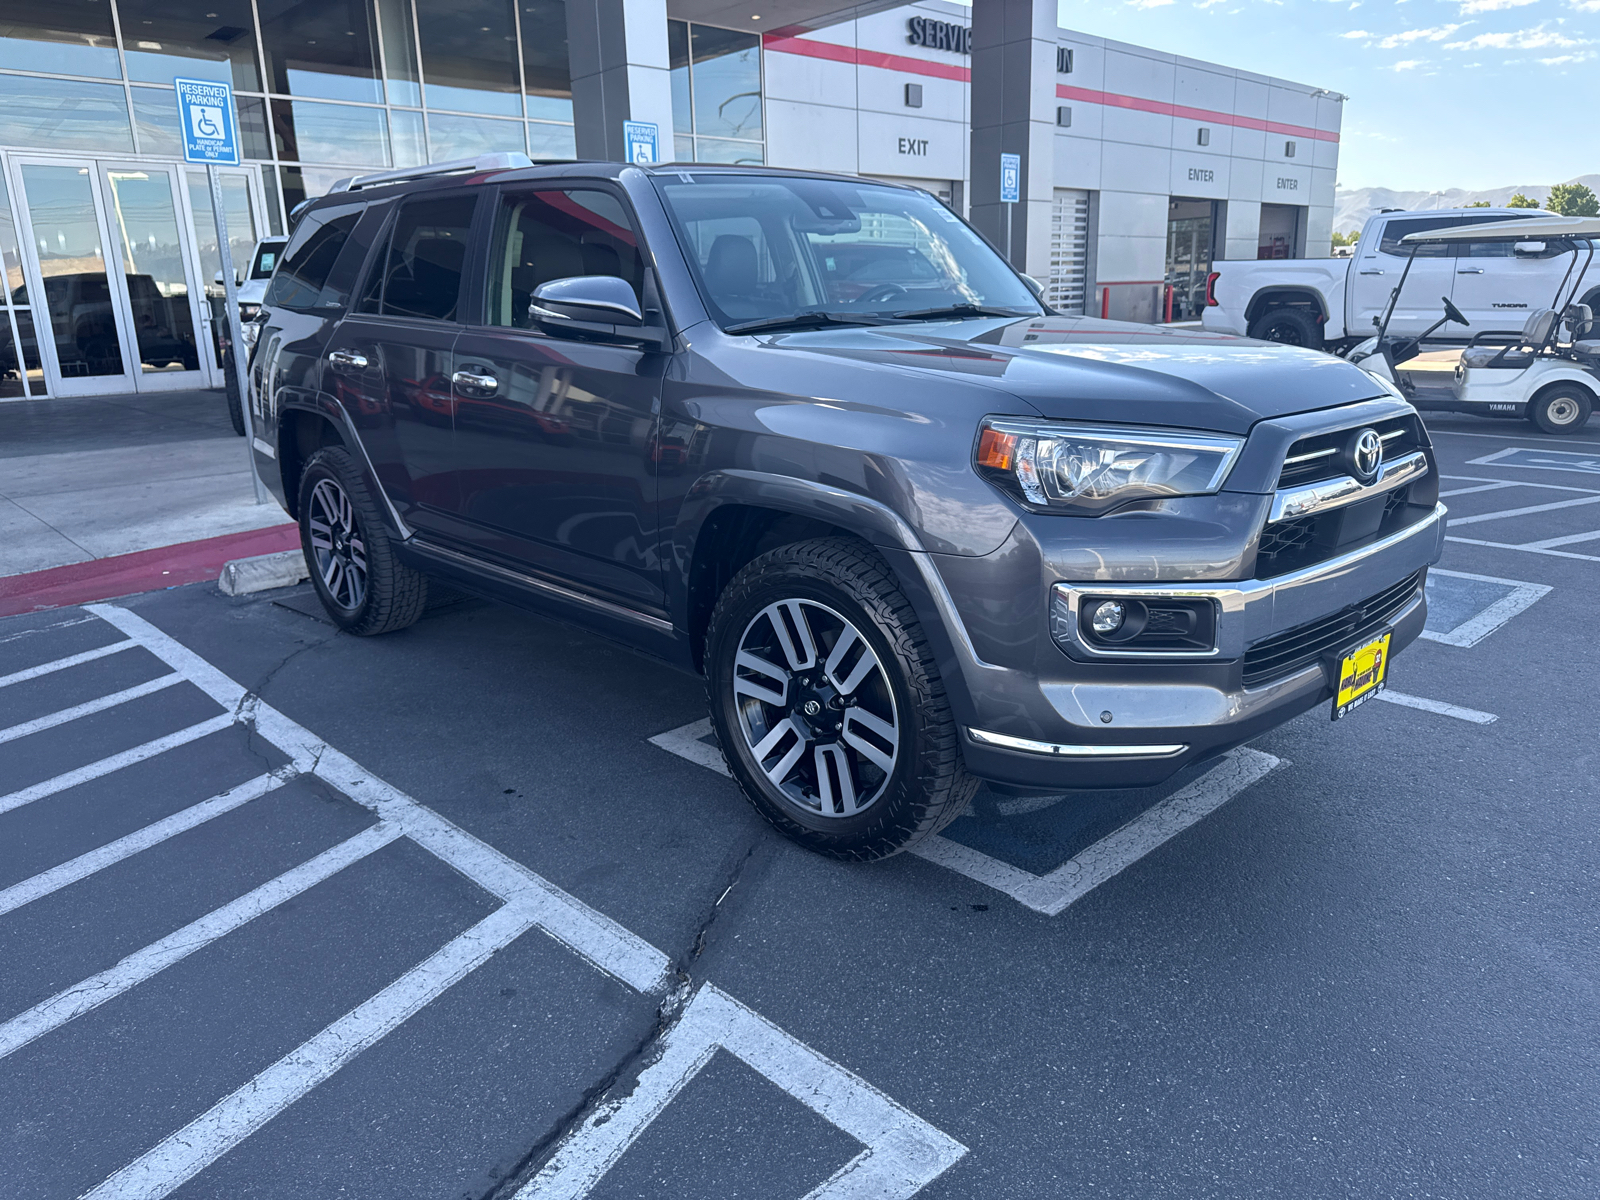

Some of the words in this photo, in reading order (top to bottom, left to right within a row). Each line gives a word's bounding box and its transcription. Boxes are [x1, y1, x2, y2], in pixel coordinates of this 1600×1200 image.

[908, 16, 972, 54] SERVIC
[181, 83, 226, 97] RESERVED
[186, 94, 224, 107] PARKING
[898, 137, 929, 156] EXIT
[1188, 168, 1214, 183] ENTER
[1277, 177, 1298, 190] ENTER
